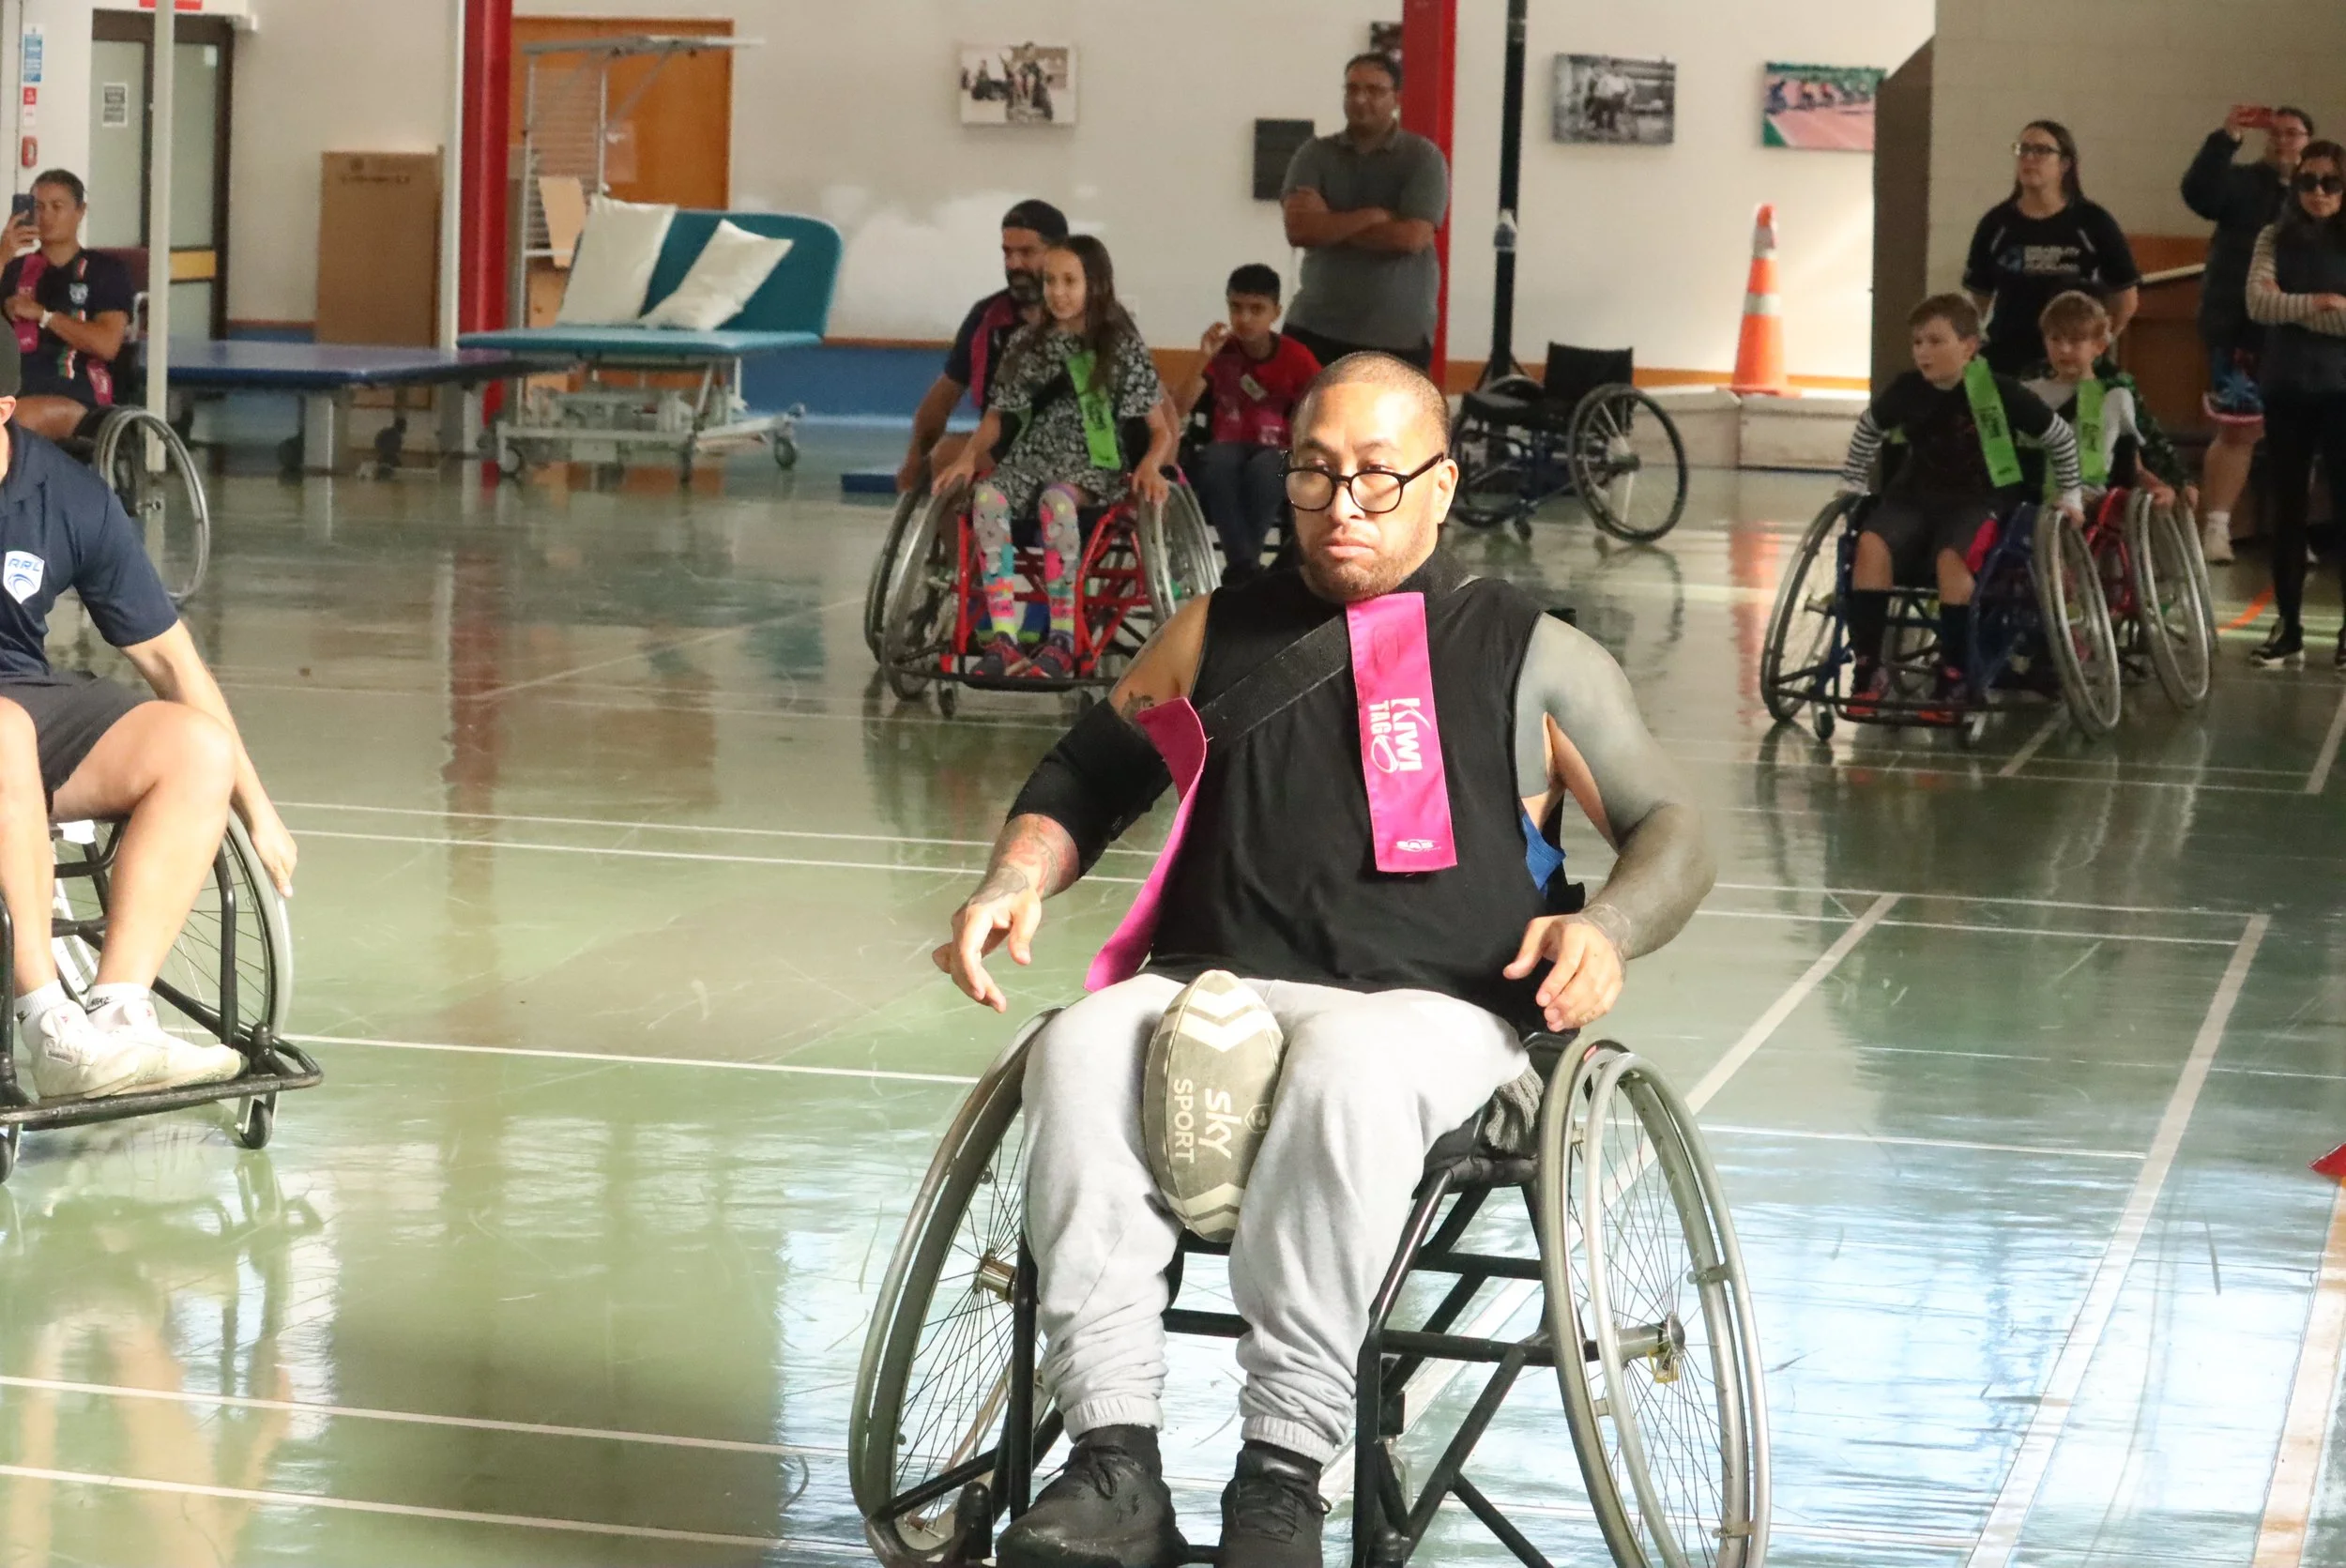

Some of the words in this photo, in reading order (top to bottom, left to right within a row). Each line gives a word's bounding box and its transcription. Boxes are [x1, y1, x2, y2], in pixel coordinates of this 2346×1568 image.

[1368, 699, 1393, 736] TAG
[1391, 697, 1432, 771] KIWI
[1173, 1078, 1196, 1164] SPORT
[1197, 1088, 1242, 1160] sky
